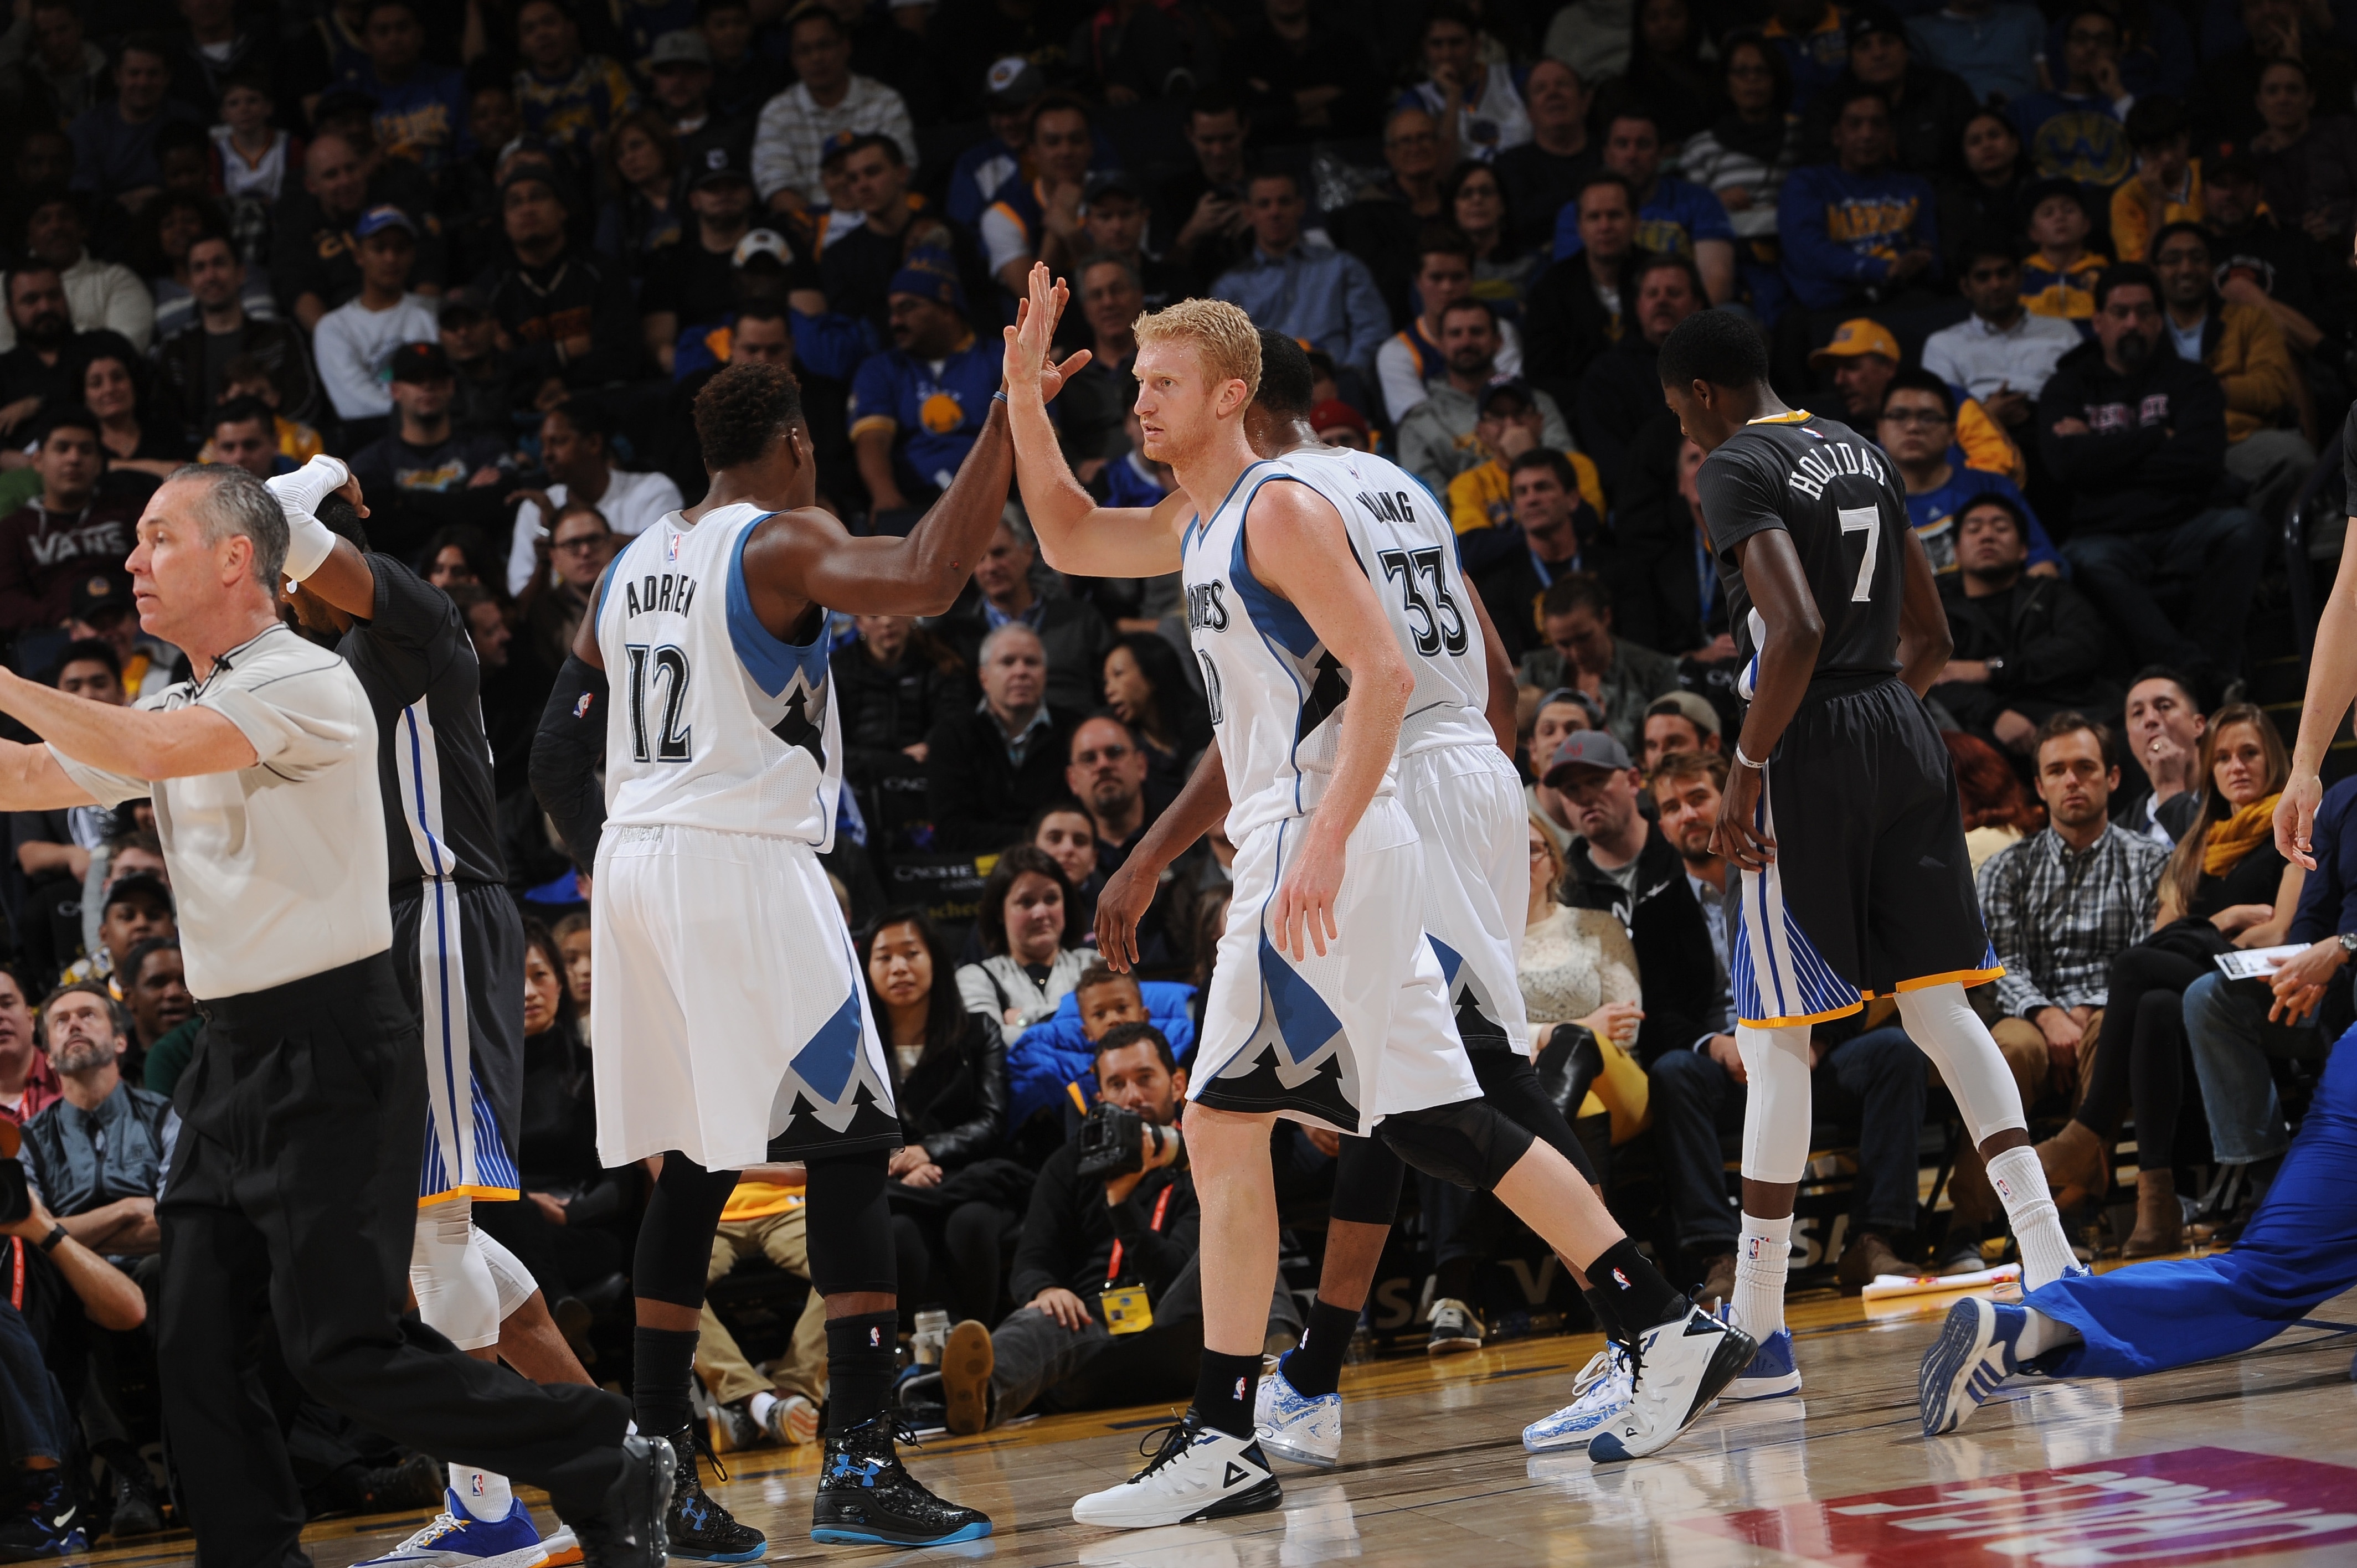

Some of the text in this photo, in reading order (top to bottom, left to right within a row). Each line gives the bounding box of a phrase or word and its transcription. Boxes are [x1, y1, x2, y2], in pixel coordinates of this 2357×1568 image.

[1789, 442, 1885, 501] HOLIDAY
[28, 520, 128, 565] VANS
[1837, 502, 1880, 602] 7
[626, 574, 697, 619] ADRIEN
[1377, 545, 1469, 657] 33
[625, 644, 692, 763] 12
[893, 864, 974, 881] CACHE
